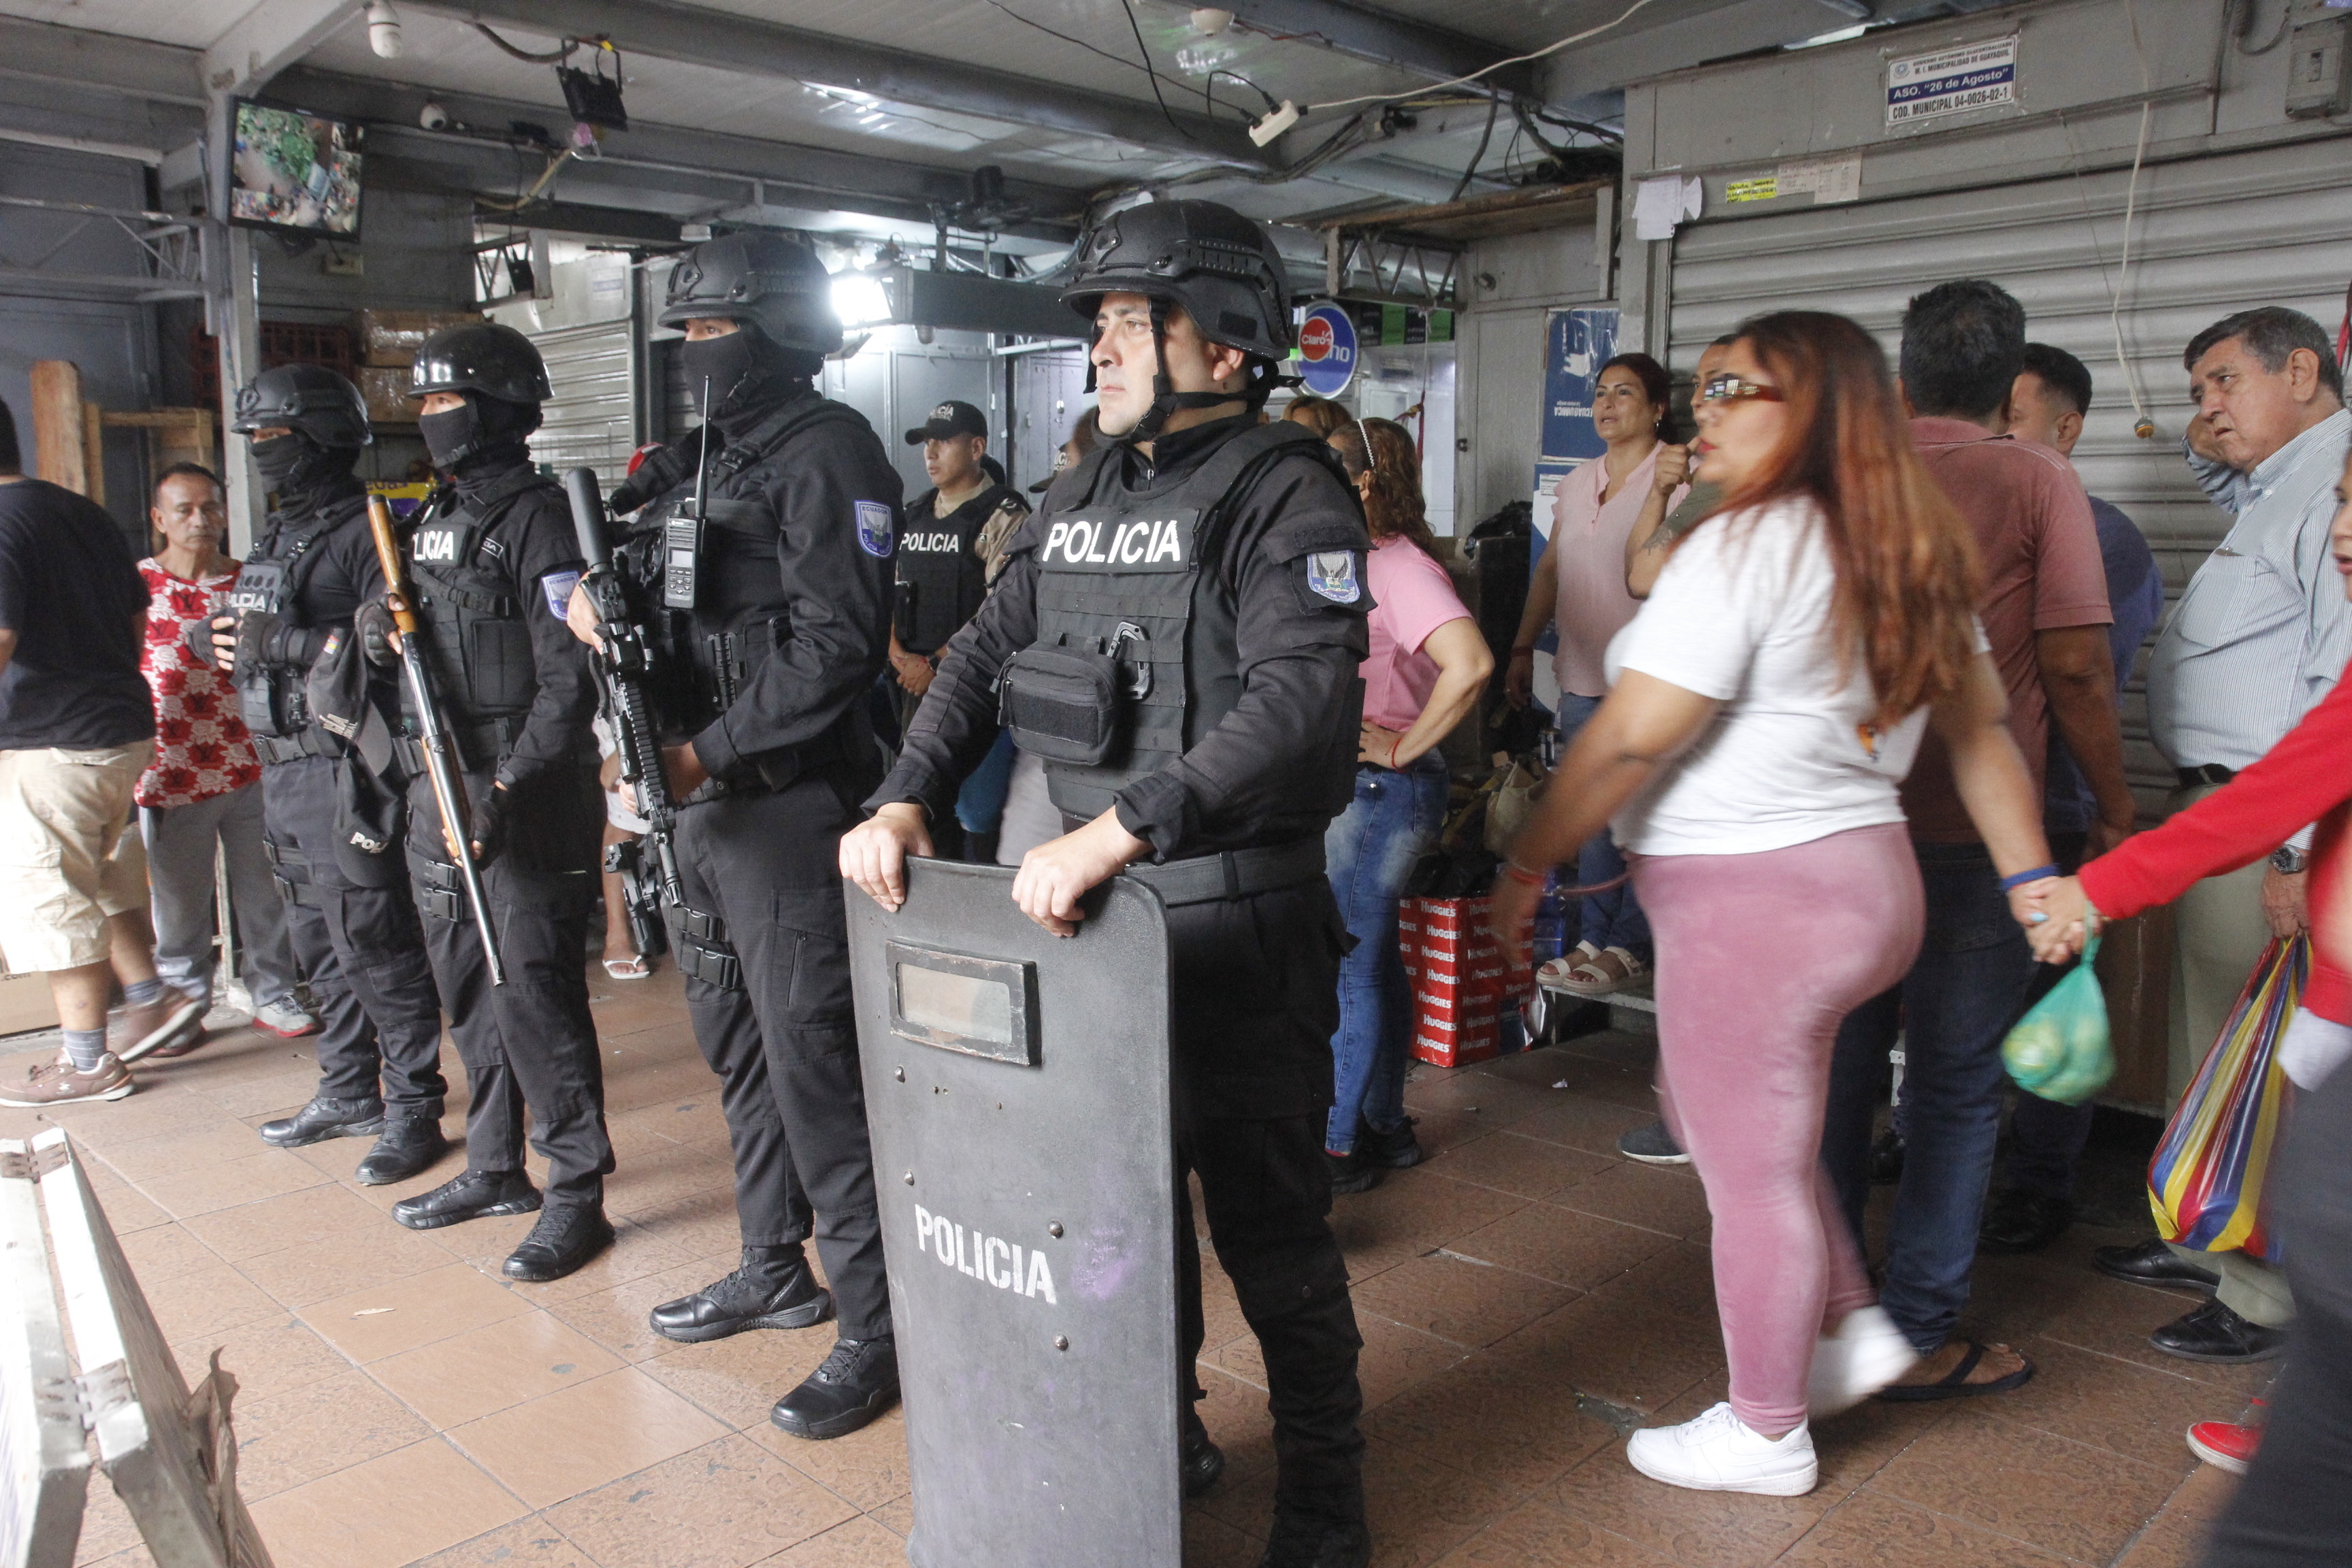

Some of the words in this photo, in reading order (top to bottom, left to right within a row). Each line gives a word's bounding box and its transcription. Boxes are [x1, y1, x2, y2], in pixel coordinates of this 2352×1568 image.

[1928, 57, 1970, 72] MUNICIPALIDAD
[1971, 55, 1978, 63] DE
[1980, 49, 2009, 61] GUAYAQUIL
[1893, 86, 1921, 99] ASO.
[1945, 78, 1959, 89] de
[1893, 105, 1910, 119] COD.
[1912, 98, 1953, 116] MUNICIPAL
[1955, 86, 2008, 108] 04-0026-02-1
[1301, 333, 1326, 346] Claro
[412, 530, 454, 561] LICIA
[899, 532, 959, 553] POLICIA
[1042, 520, 1181, 564] POLICIA
[1421, 901, 1456, 917] HUGGIES
[1426, 924, 1462, 940] HUGGIES
[1422, 945, 1456, 962] HUGGIES
[1427, 968, 1460, 985] HUGGIES
[1418, 990, 1452, 1009] HUGGIES
[1423, 1014, 1457, 1032] HUGGIES
[1417, 1034, 1450, 1053] HUGGIES
[915, 1204, 1057, 1305] POLICIA
